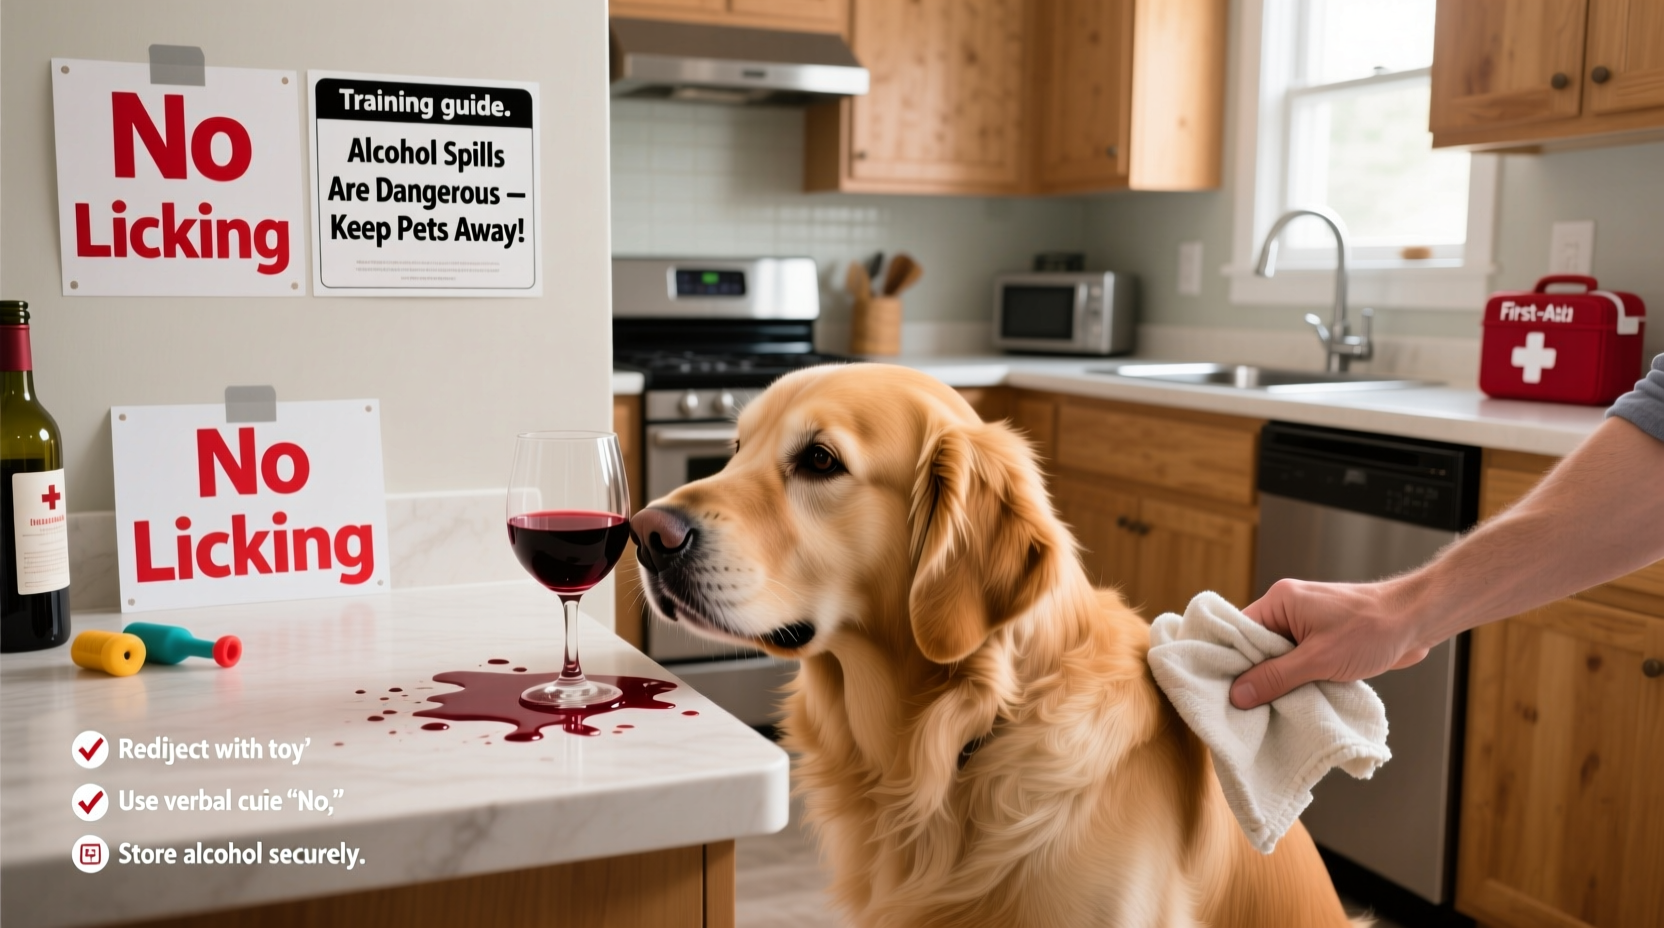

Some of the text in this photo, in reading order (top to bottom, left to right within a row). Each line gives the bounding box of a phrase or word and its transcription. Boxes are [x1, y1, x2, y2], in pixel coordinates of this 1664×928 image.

[339, 89, 511, 119] Training guide.
[111, 92, 252, 182] No
[347, 137, 505, 172] Alcohol Spills
[327, 176, 370, 202] Are
[376, 176, 500, 210] Dangerous
[75, 200, 290, 275] Licking
[330, 214, 524, 249] Keep Pets Away!
[196, 427, 310, 497] No
[134, 511, 374, 585] Licking
